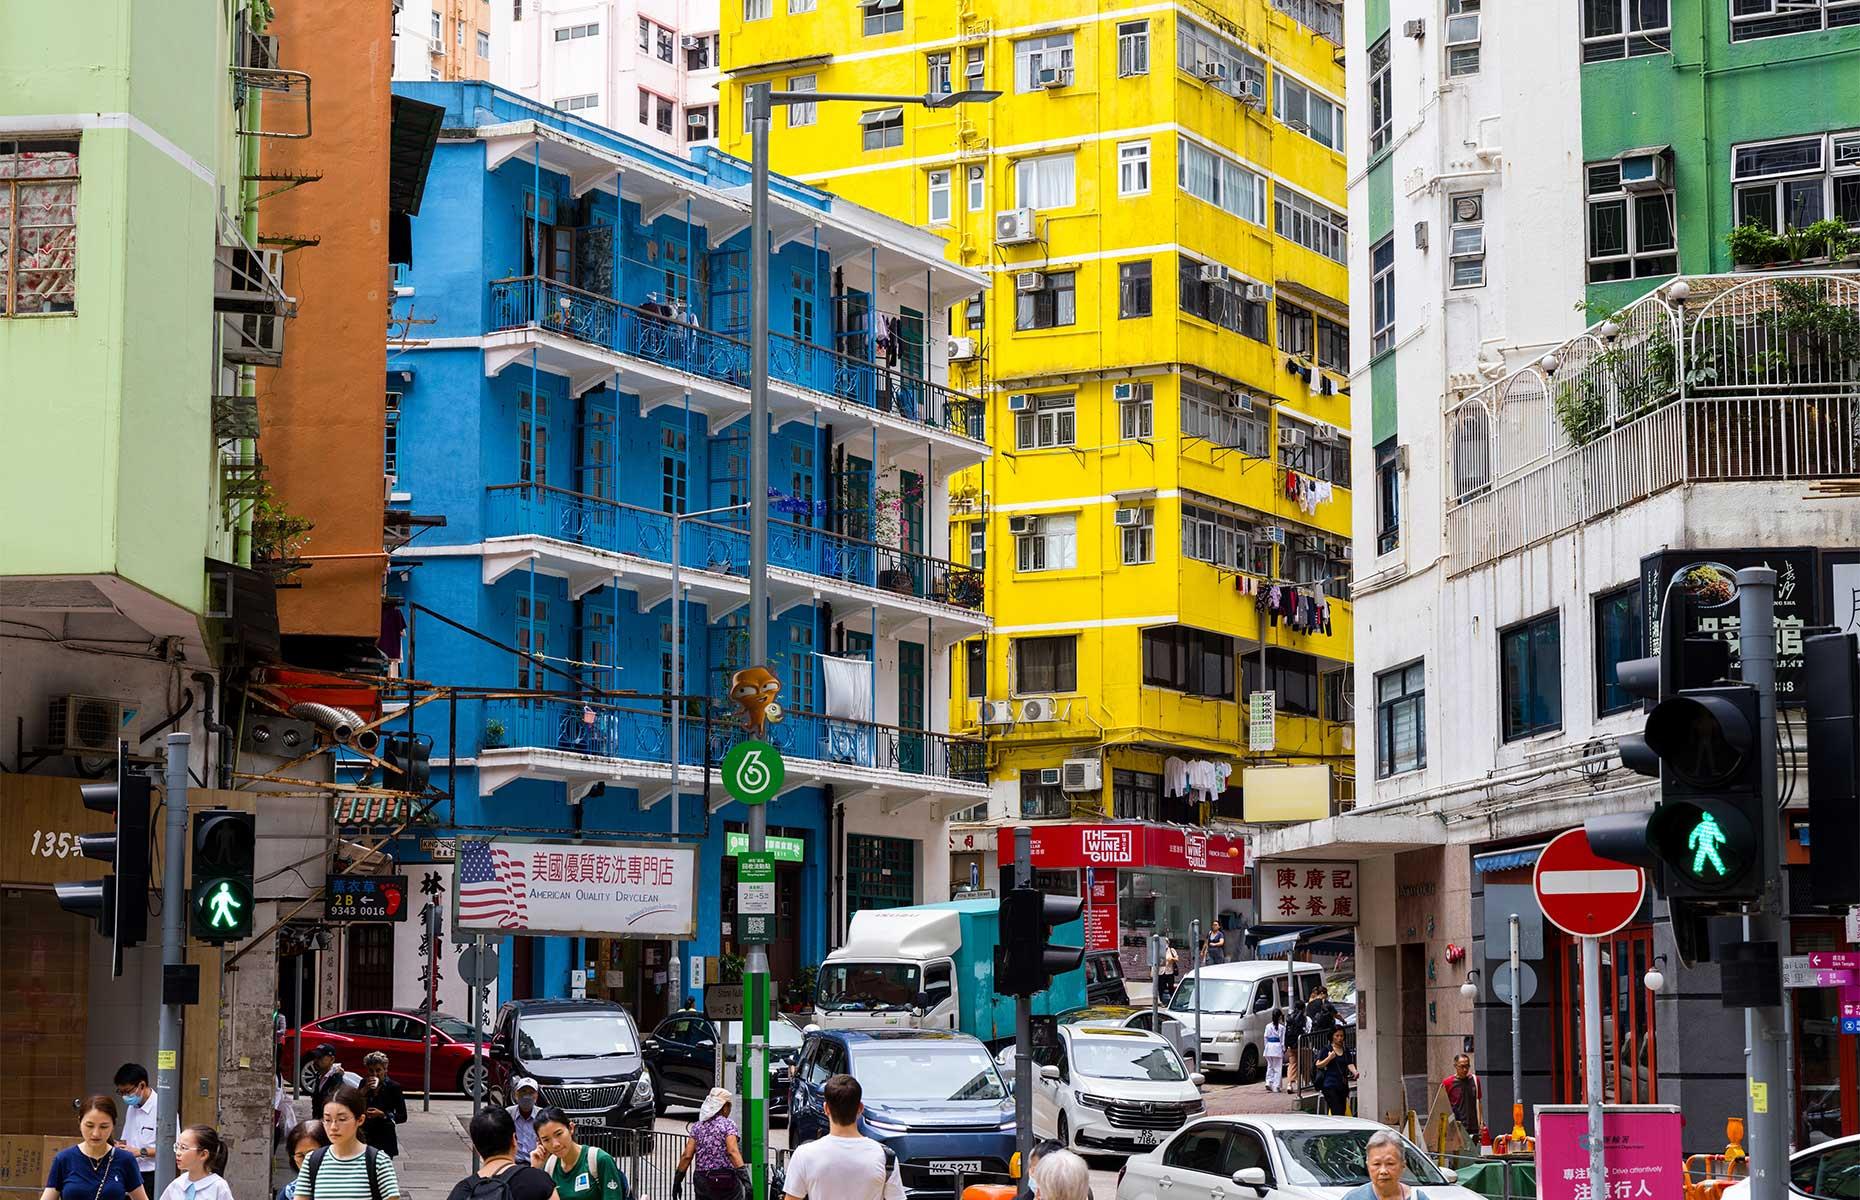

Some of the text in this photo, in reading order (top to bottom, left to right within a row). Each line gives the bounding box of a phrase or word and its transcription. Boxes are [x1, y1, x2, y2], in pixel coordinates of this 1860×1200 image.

[1086, 830, 1107, 840] THE
[1088, 841, 1119, 851] WINE
[1187, 845, 1201, 856] WINE
[1090, 852, 1129, 862] GUILD
[1189, 857, 1206, 867] GUILD
[531, 852, 674, 886] 美國優質乾洗專門店
[1276, 867, 1352, 890] 陳廣記
[331, 907, 385, 916] 9343 0016
[1277, 896, 1353, 917] 茶餐廳
[582, 1118, 603, 1126] 1963
[932, 1163, 978, 1173] KK 5273
[1612, 1166, 1663, 1175] Drive attentively
